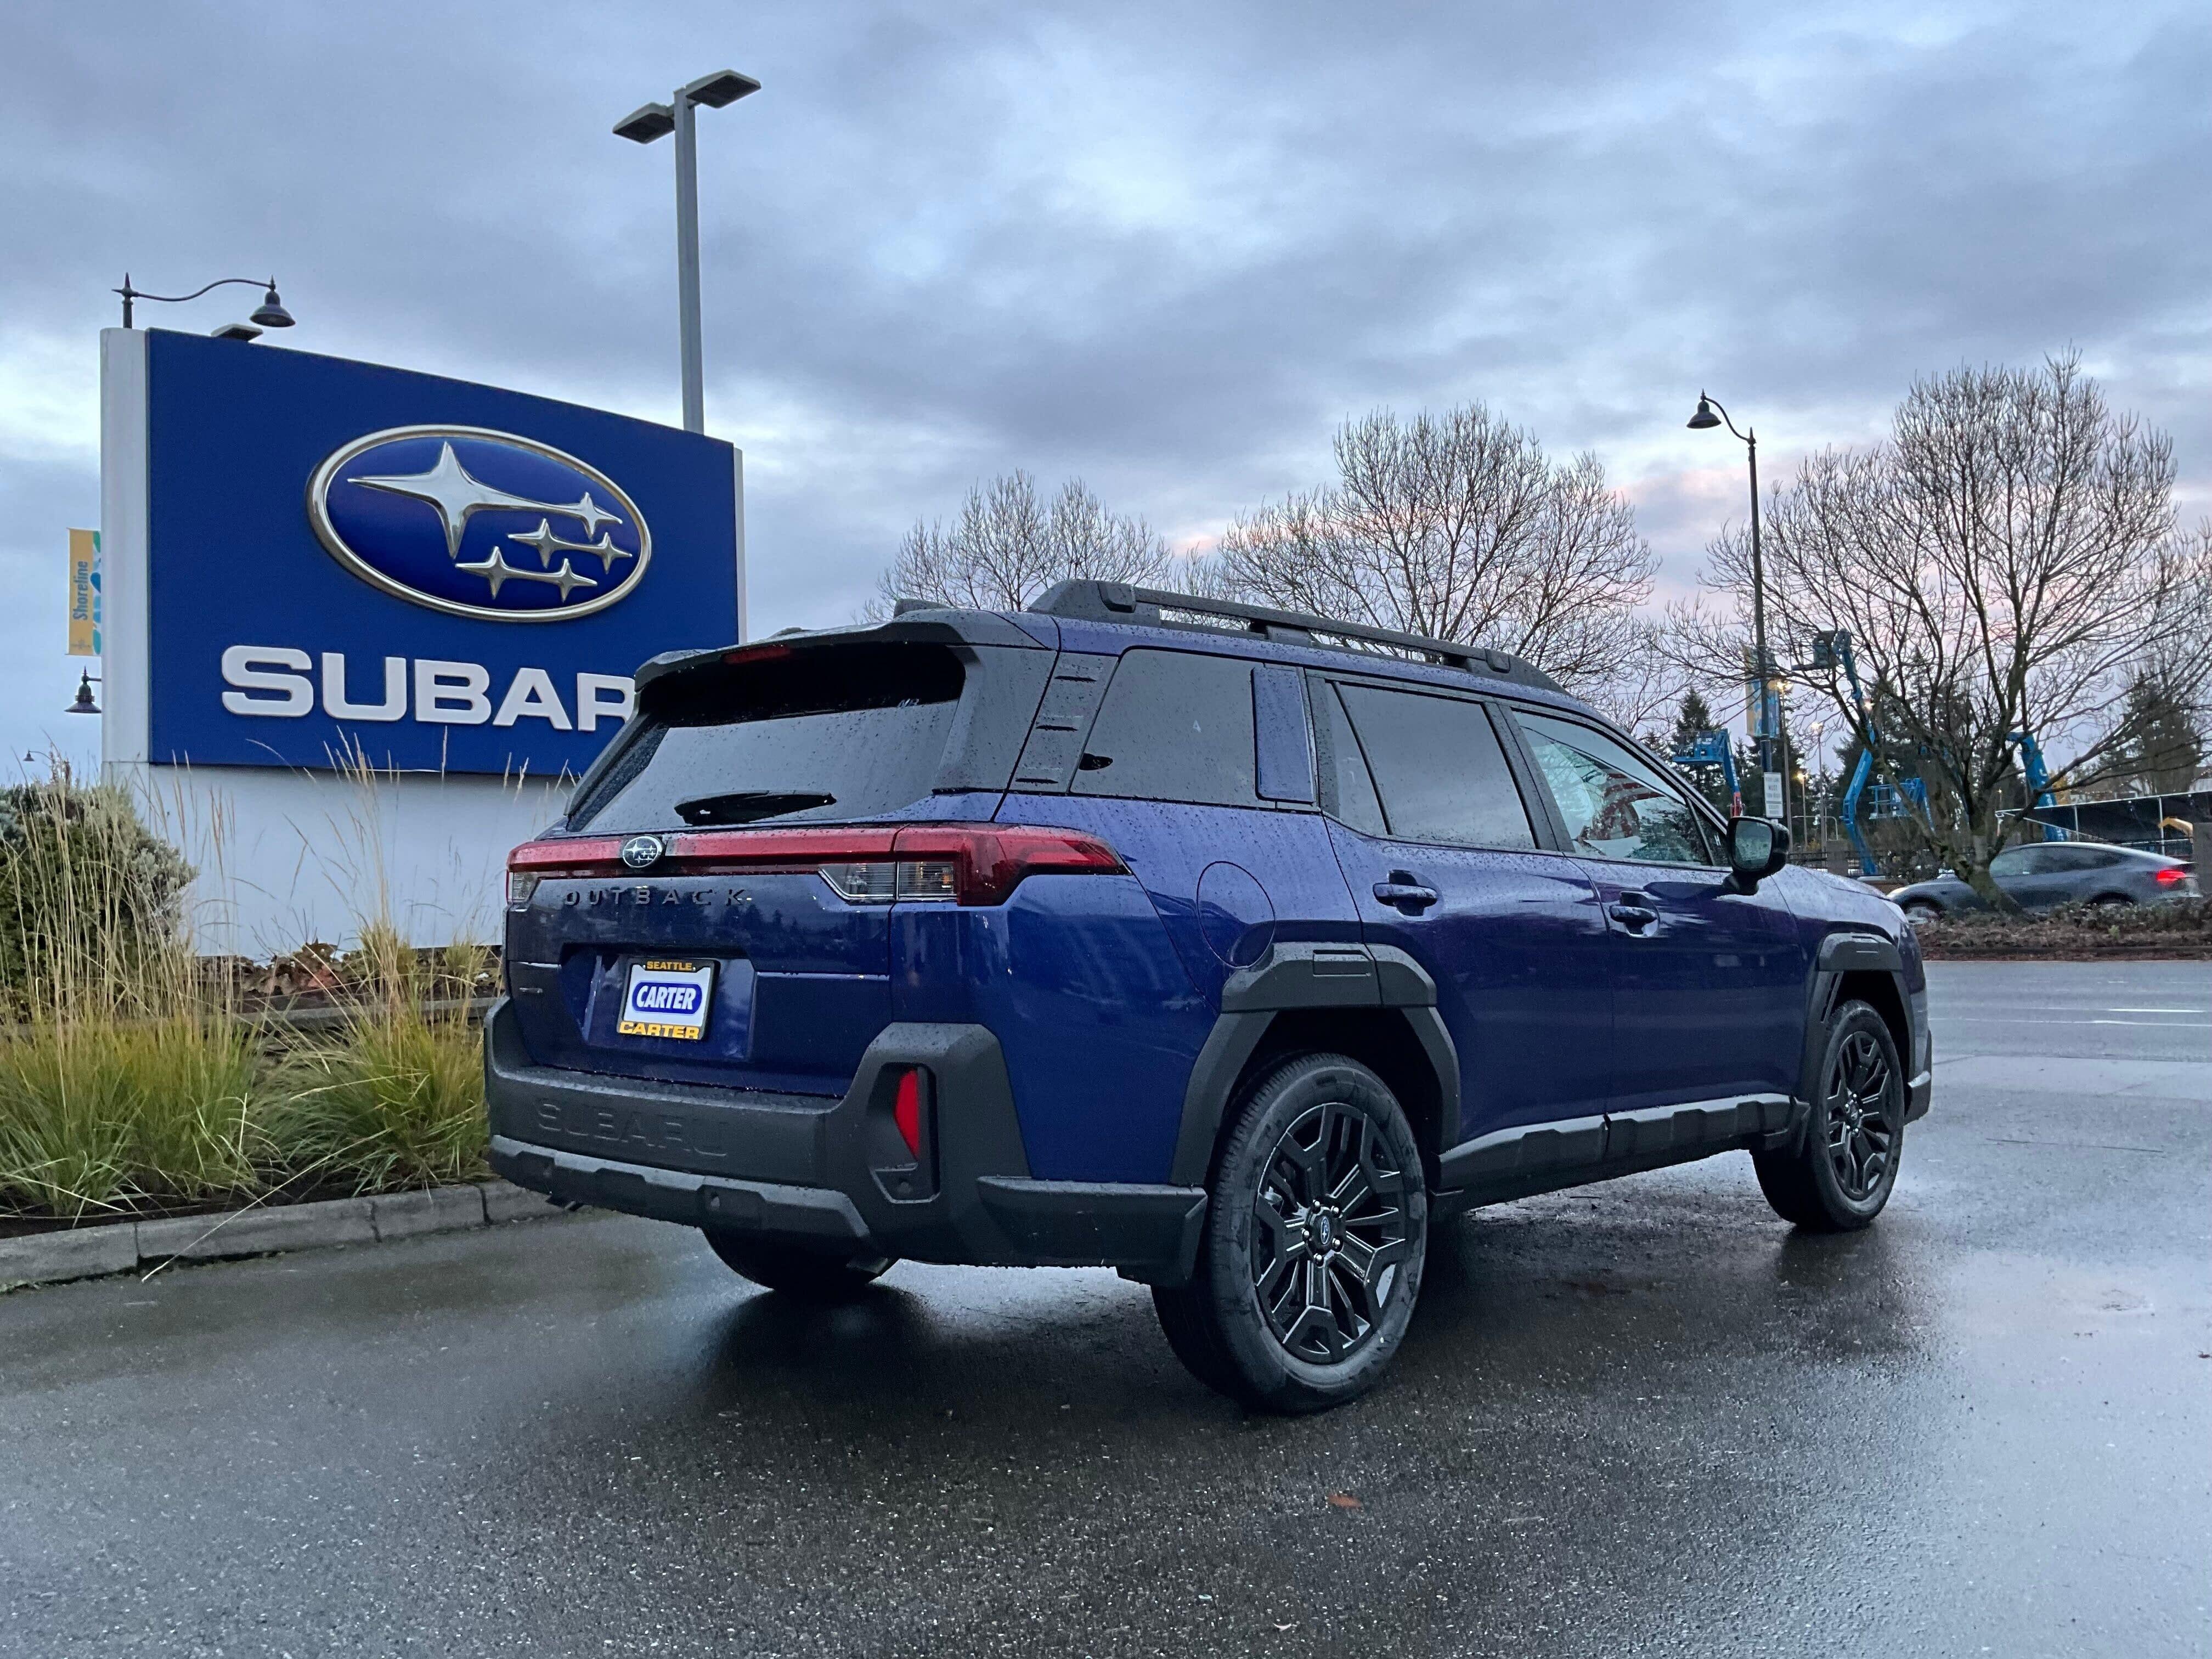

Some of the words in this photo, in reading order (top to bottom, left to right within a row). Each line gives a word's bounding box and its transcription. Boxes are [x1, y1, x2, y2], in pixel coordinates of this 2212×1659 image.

[72, 560, 88, 621] Shoreline
[221, 644, 635, 731] SUBAR
[564, 887, 744, 906] OUTBACK
[646, 961, 692, 970] SEATTLE
[636, 985, 697, 1010] CARTER
[619, 1020, 699, 1040] CARTER
